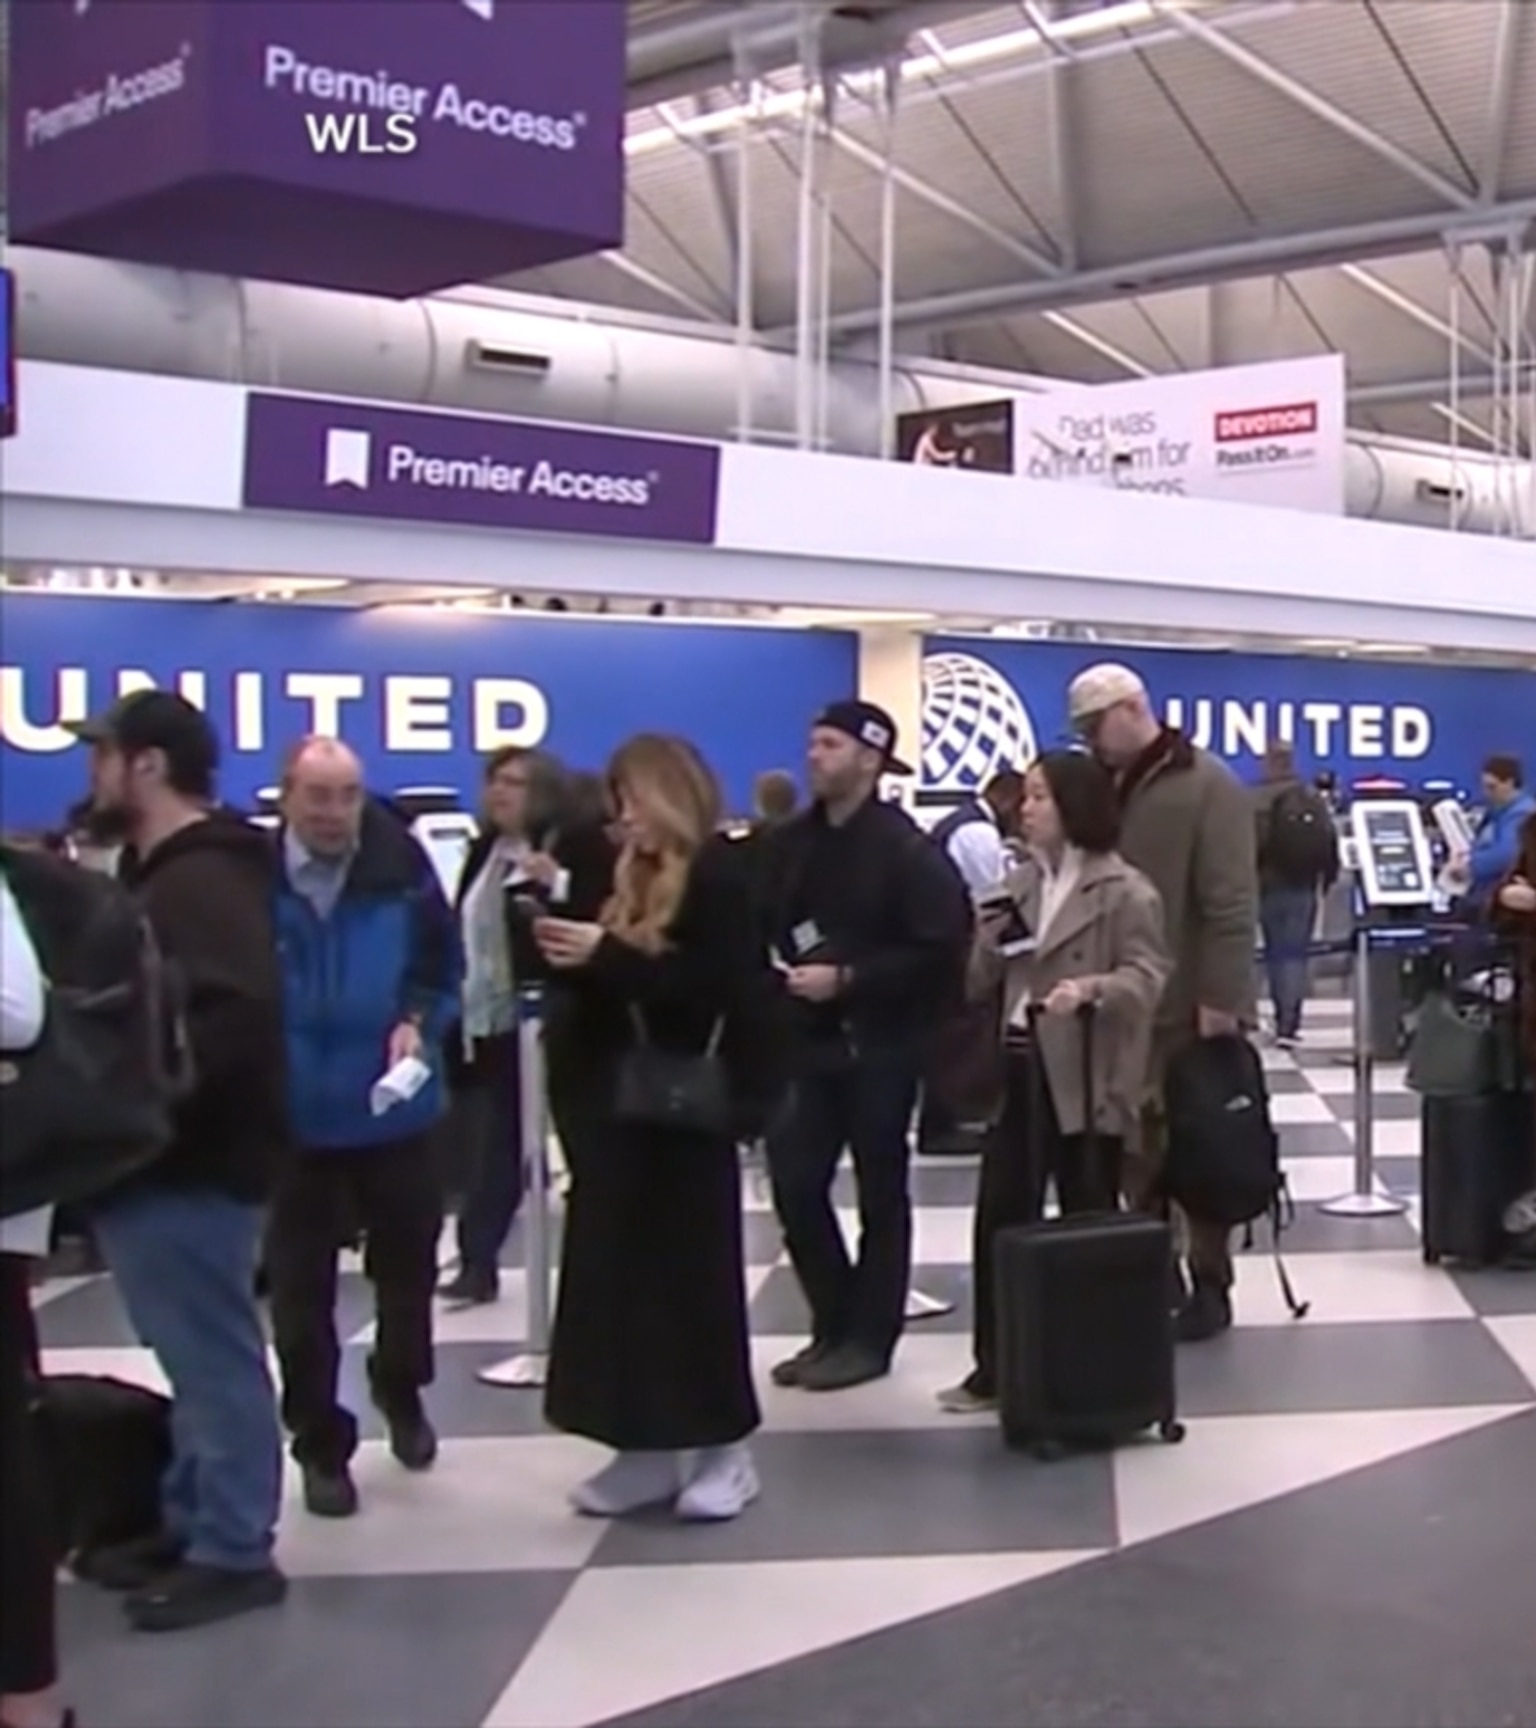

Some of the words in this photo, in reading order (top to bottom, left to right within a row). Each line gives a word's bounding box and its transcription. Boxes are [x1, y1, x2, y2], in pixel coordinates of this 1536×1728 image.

[264, 45, 428, 116] Premier
[26, 90, 103, 149] Premier
[387, 444, 526, 492] Premier
[1166, 698, 1432, 757] UNITED
